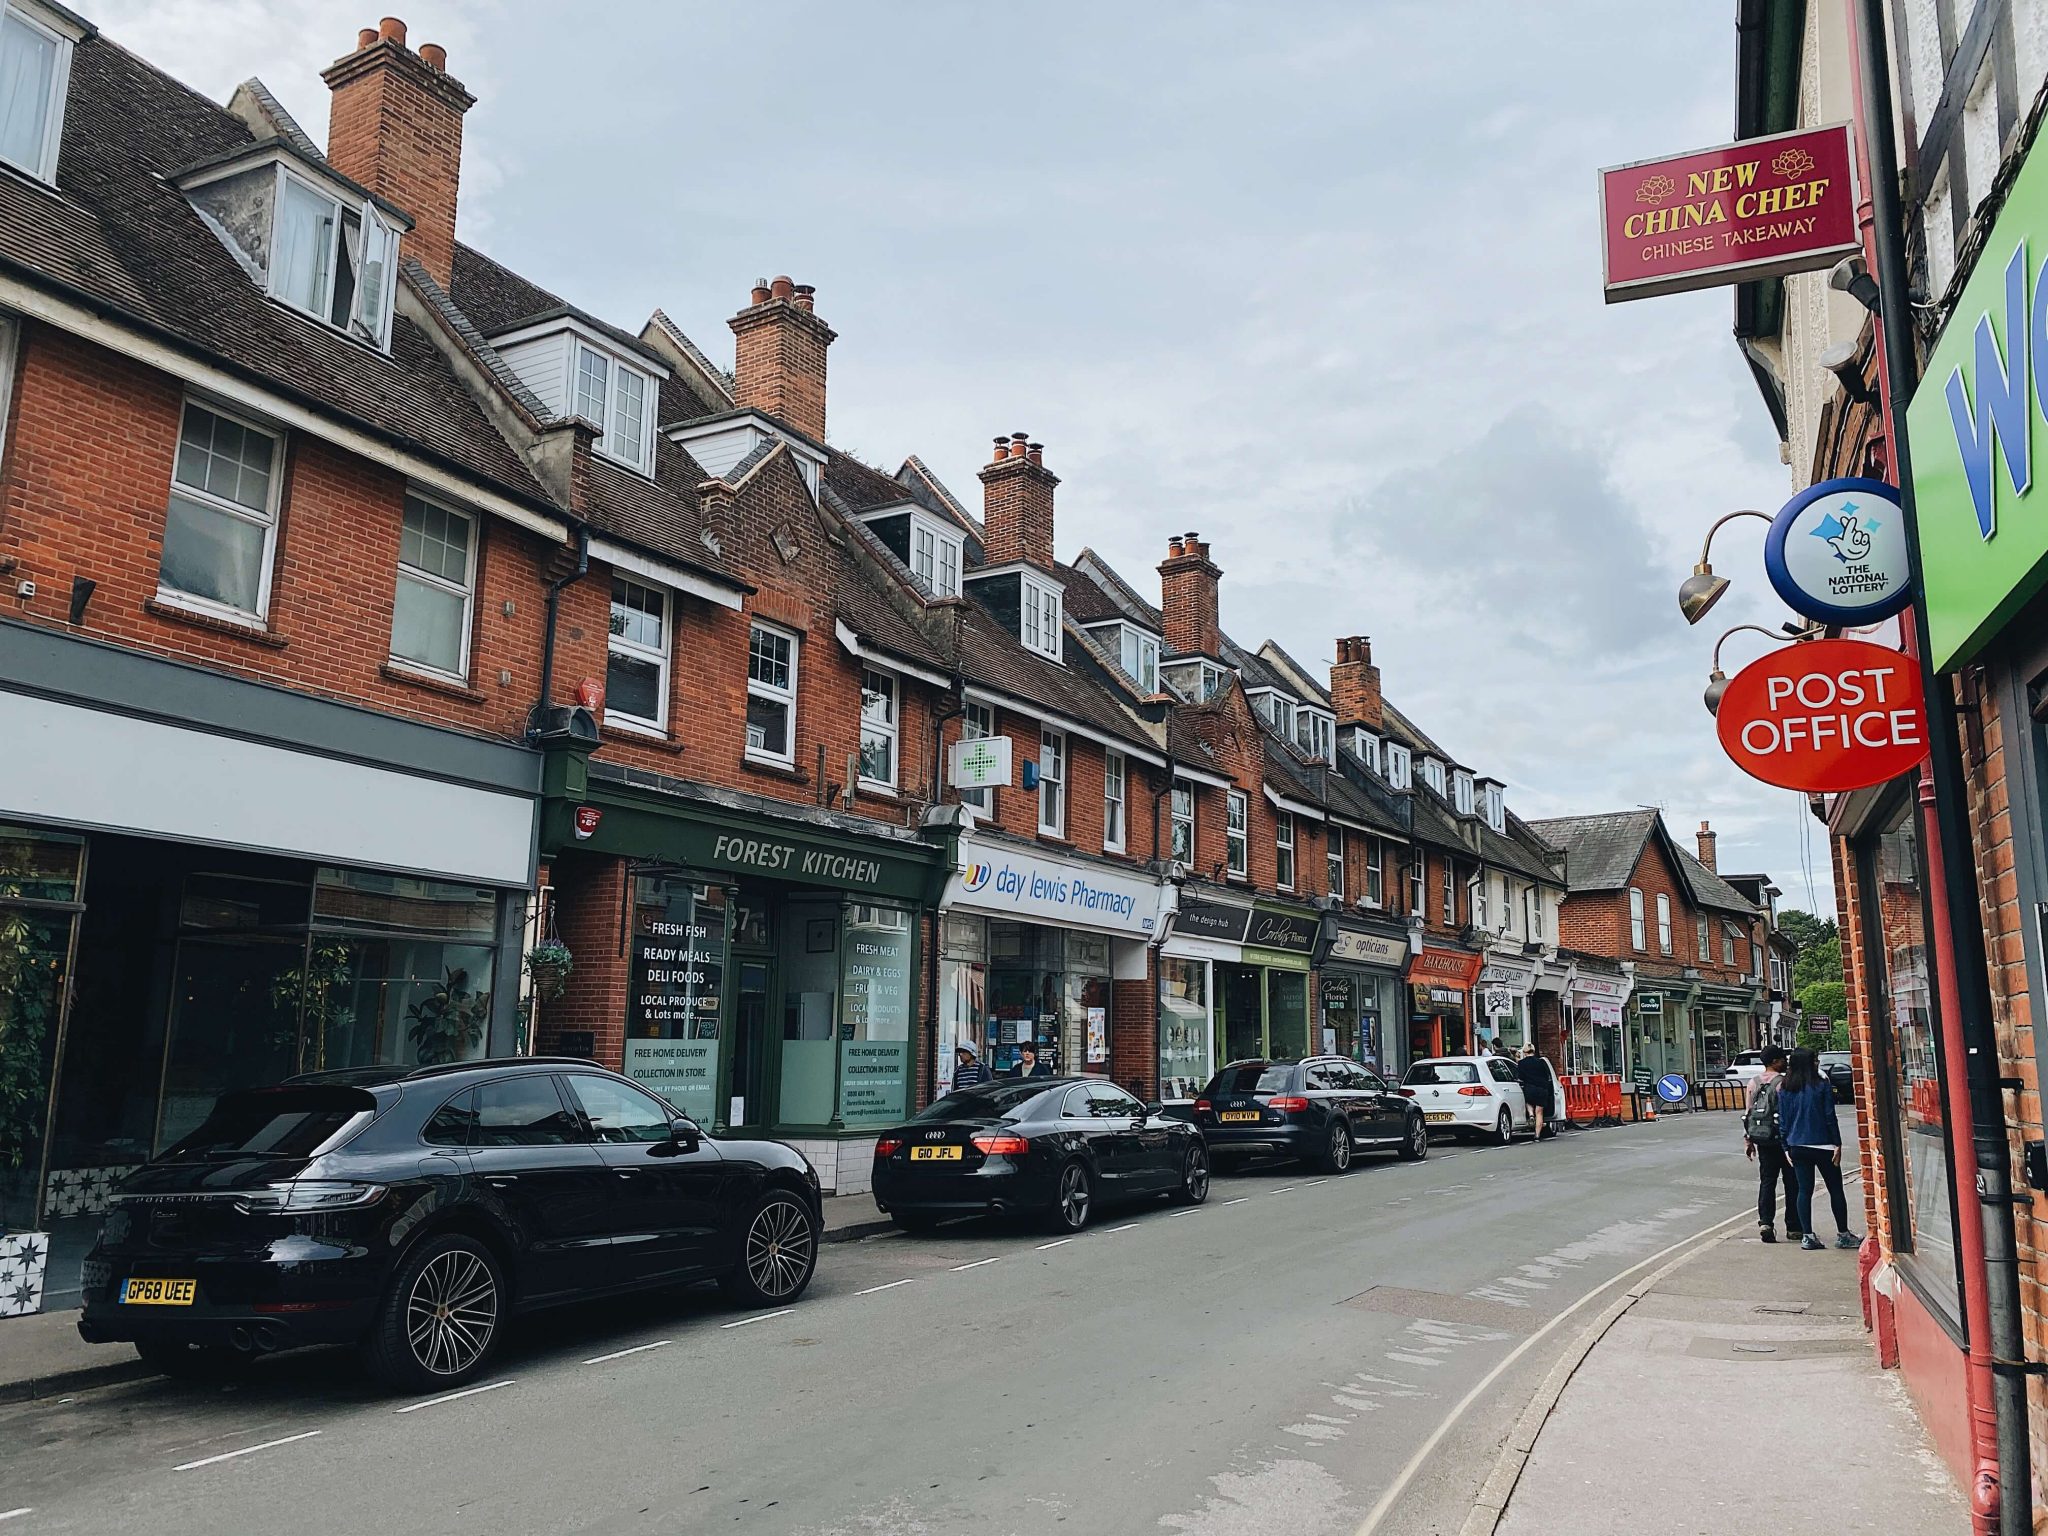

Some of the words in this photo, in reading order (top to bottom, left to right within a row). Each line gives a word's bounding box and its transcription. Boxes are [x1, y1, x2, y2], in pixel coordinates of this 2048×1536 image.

[1686, 160, 1760, 198] NEW
[1624, 200, 1728, 239] CHINA
[1735, 178, 1830, 219] CHEF
[1642, 235, 1715, 261] CHINESE
[1721, 217, 1817, 247] TAKEAWAY
[1943, 236, 2048, 542] W
[1846, 564, 1870, 574] THE
[1829, 572, 1888, 586] NATIONAL
[1833, 582, 1886, 595] LOTTERY
[1767, 667, 1895, 711] POST
[1741, 709, 1921, 756] OFFICE
[713, 835, 795, 870] FOREST
[801, 850, 881, 884] KITCHEN
[996, 864, 1026, 901] day
[1029, 870, 1067, 903] lewis
[1070, 880, 1136, 920] Pharmacy
[1142, 918, 1154, 929] NHS
[1189, 914, 1199, 923] the
[1200, 915, 1217, 928] design
[1218, 917, 1229, 928] hub
[652, 922, 683, 936] FRESH
[685, 925, 706, 938] FISH
[856, 943, 878, 955] FRESH
[880, 946, 899, 957] MEAT
[1356, 939, 1389, 955] opticians
[643, 947, 677, 961] READY
[679, 950, 710, 963] MEALS
[1423, 955, 1466, 973] BAKEHOUSE
[648, 969, 669, 982] DELI
[671, 971, 705, 984] FOODS
[852, 965, 875, 976] DAIRY
[875, 967, 881, 977] &
[883, 968, 901, 978] EGGS
[884, 986, 898, 996] VEG
[1325, 993, 1348, 1001] Florist
[640, 995, 667, 1006] LOCAL
[669, 996, 707, 1007] PRODUCE
[645, 1008, 652, 1019] &
[654, 1009, 671, 1019] Lots
[634, 1049, 651, 1058] FREE
[652, 1049, 675, 1058] HOME
[676, 1048, 708, 1058] DELIVERY
[633, 1068, 676, 1079] COLLECTION
[676, 1069, 684, 1077] IN
[685, 1068, 706, 1077] STORE
[848, 1066, 878, 1074] COLLECTION
[884, 1065, 900, 1073] STORE
[917, 1148, 932, 1159] G10
[936, 1147, 954, 1159] JFL
[128, 1281, 162, 1300] GP68
[164, 1281, 193, 1301] UEE
